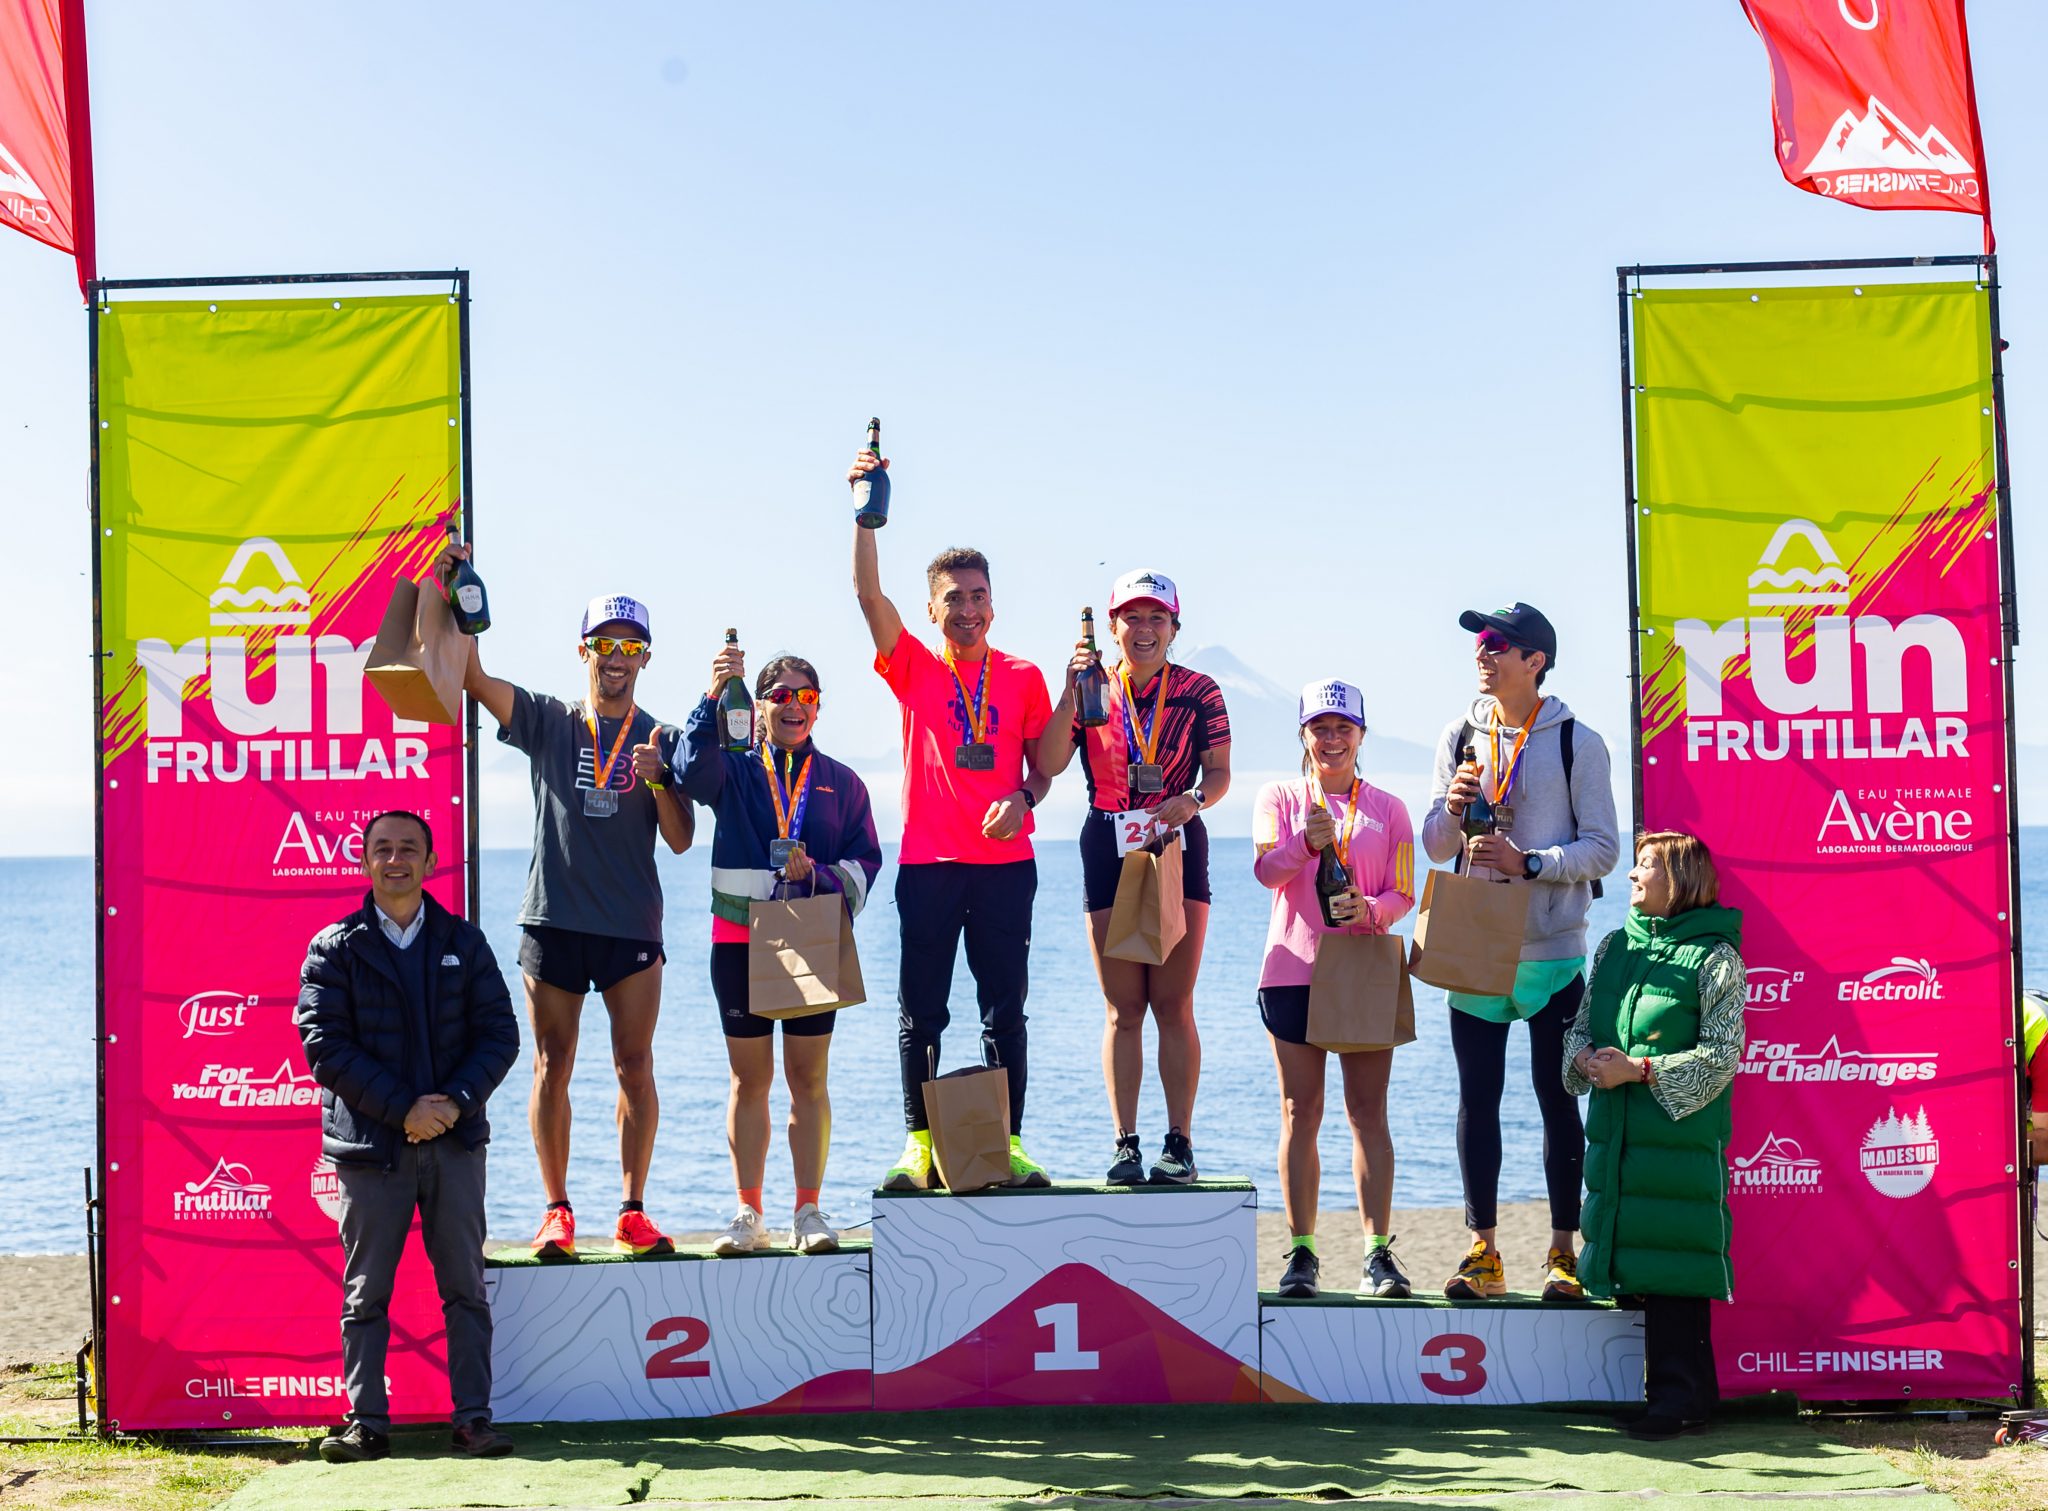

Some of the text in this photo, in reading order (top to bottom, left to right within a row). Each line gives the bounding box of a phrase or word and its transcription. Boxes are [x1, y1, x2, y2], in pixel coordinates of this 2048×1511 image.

[605, 597, 635, 608] SWIM
[605, 604, 635, 614] BIKE
[605, 611, 635, 620] RUN
[1674, 614, 1969, 717] run
[1320, 684, 1346, 693] WIM
[1687, 717, 1970, 762] FRUTILLAR
[147, 738, 430, 783] FRUTILLAR
[1858, 787, 1973, 800] EAU THERMALE
[315, 811, 345, 822] EAU
[1103, 811, 1115, 821] TY
[1816, 789, 1973, 842] Avène
[272, 811, 363, 864] Avè
[1816, 844, 1974, 854] LABORATOIRE DERMATOLOGIQUE
[272, 867, 338, 877] LABORATOIRE
[1747, 978, 1793, 1003] ust
[1837, 980, 1943, 1001] Electrolit
[183, 1001, 247, 1039] Just
[1746, 1040, 1800, 1060] For
[199, 1064, 254, 1085] For
[219, 1083, 322, 1107] Challen
[1862, 1145, 1938, 1168] MADESUR
[173, 1189, 272, 1212] Frutillar
[1727, 1185, 1823, 1195] UNICIPALIDAD
[174, 1211, 273, 1221] MUNICIPALIDAD
[1034, 1302, 1099, 1371] 1
[645, 1316, 711, 1380] 2
[1420, 1333, 1488, 1397] 3
